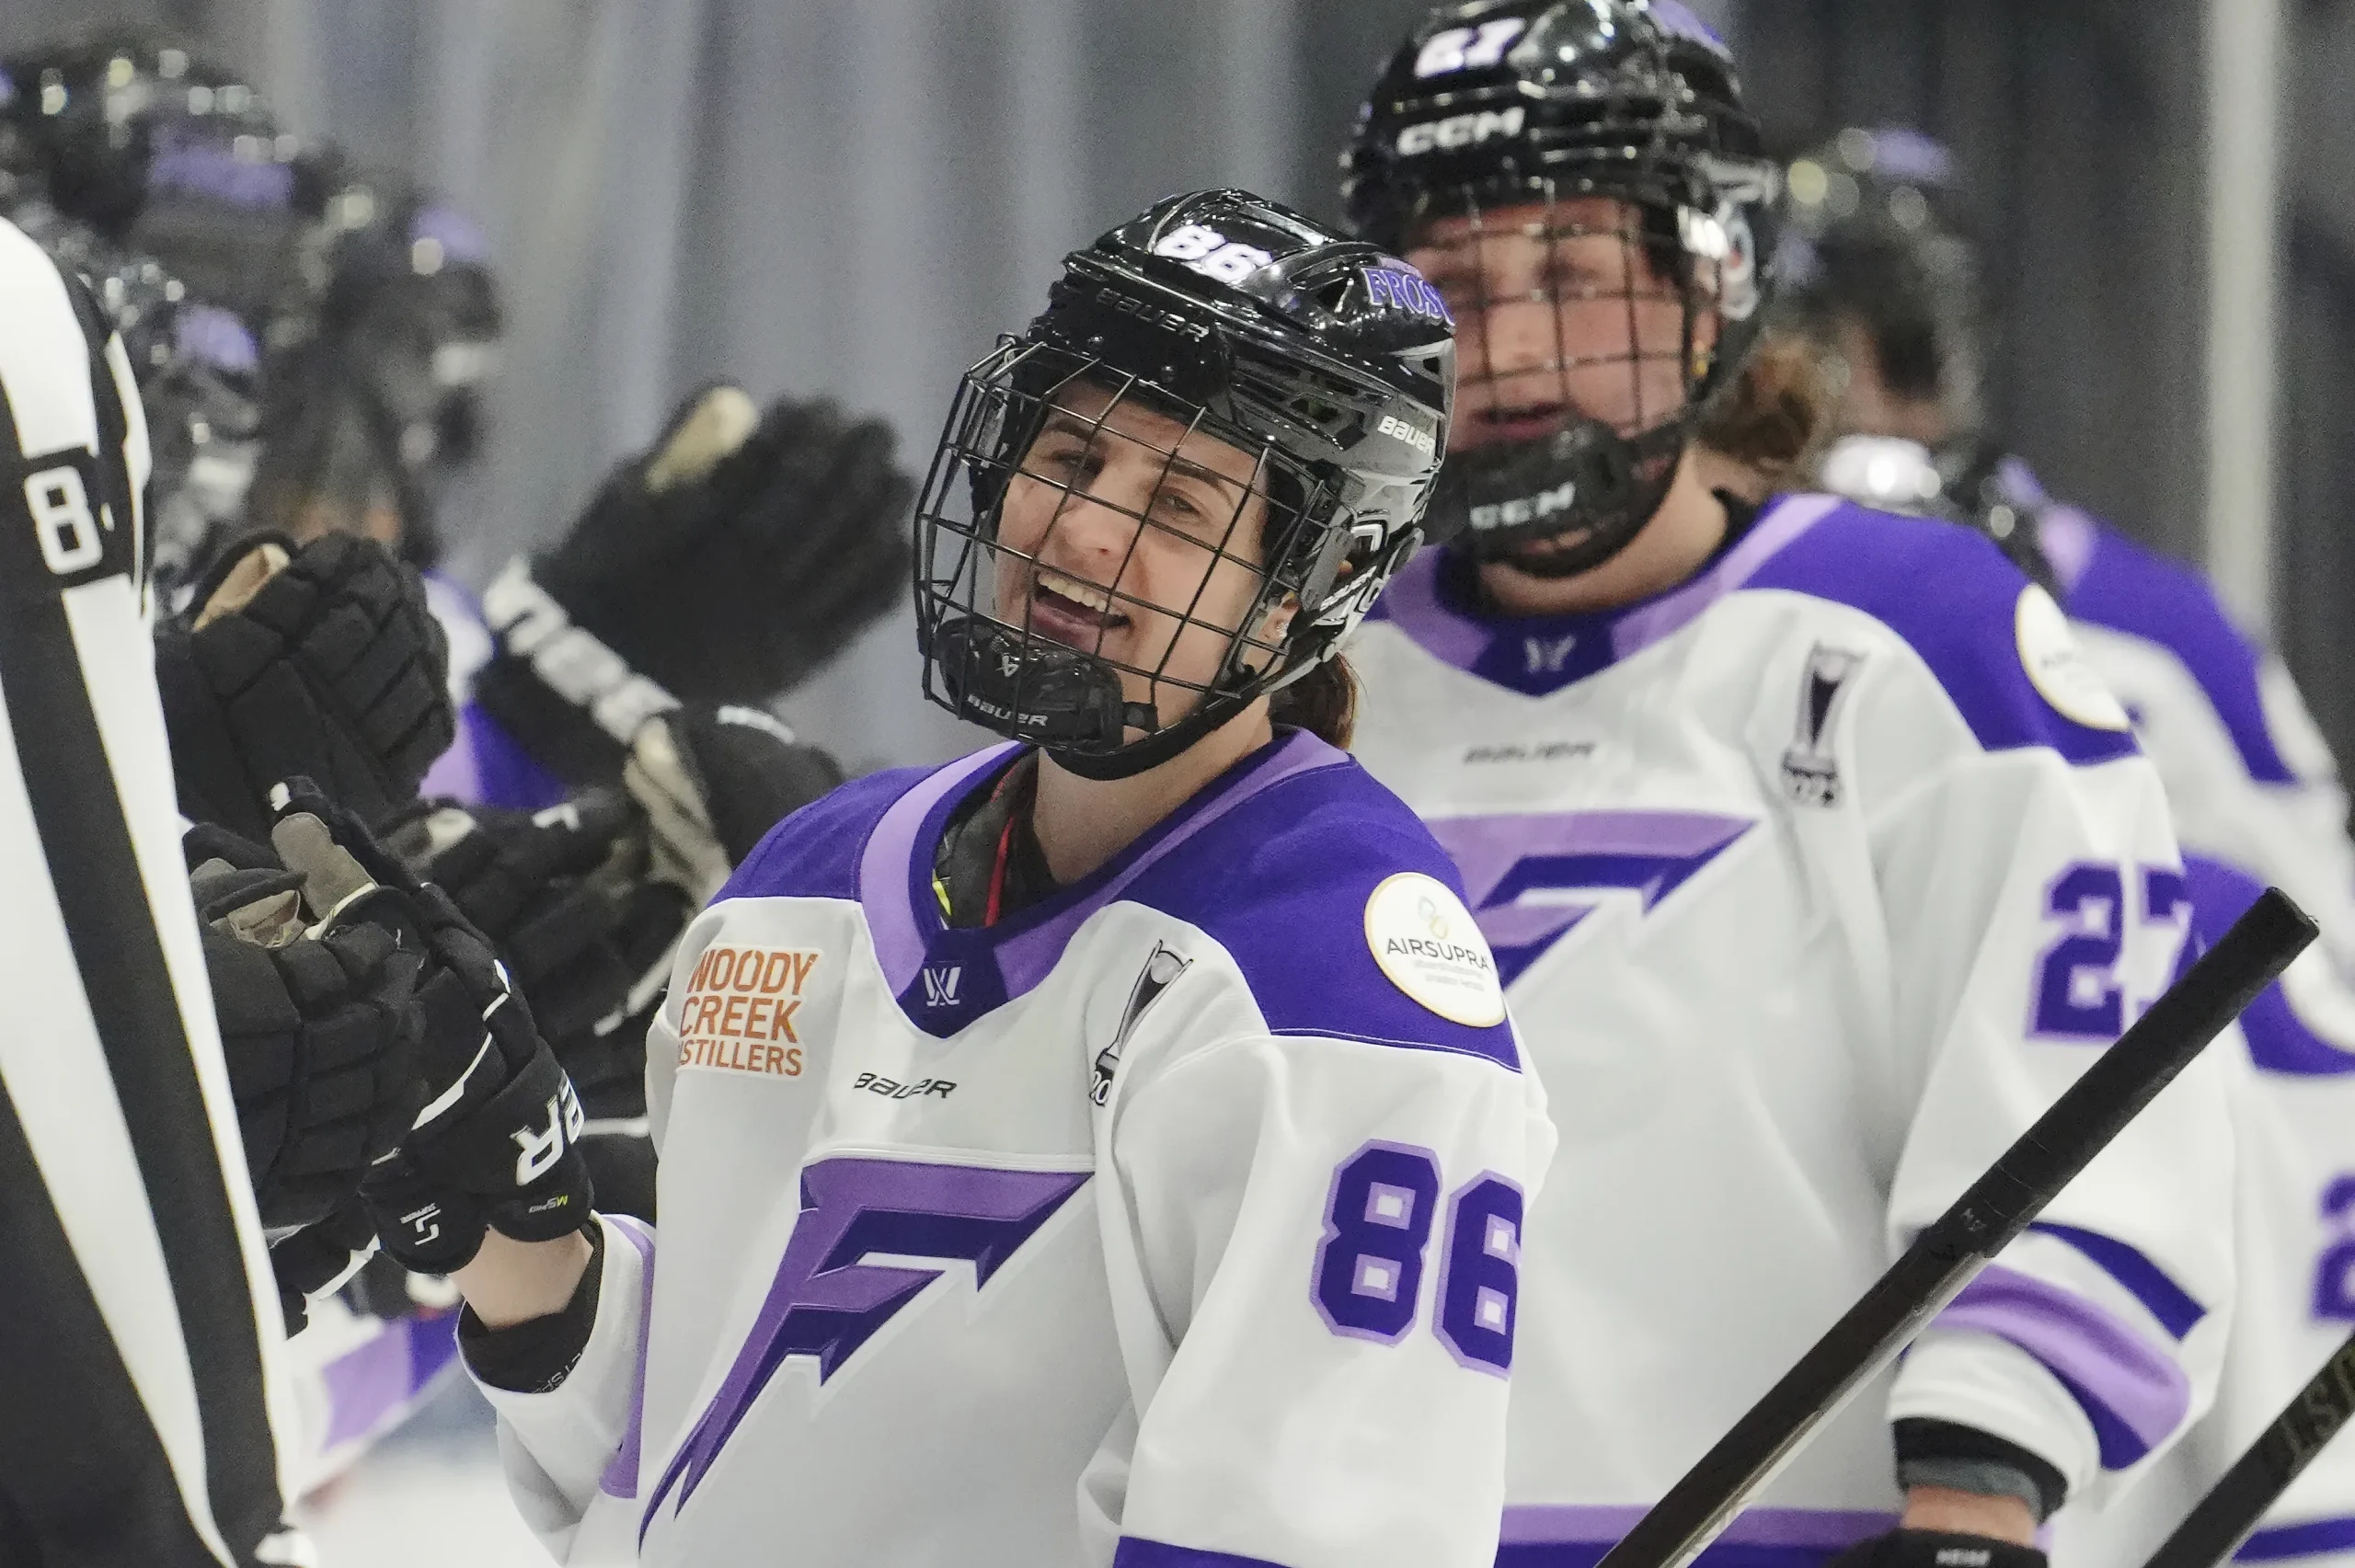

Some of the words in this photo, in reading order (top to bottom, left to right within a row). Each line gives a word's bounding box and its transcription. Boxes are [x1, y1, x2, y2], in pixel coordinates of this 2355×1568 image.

[1396, 106, 1525, 156] CCM
[1153, 224, 1273, 283] 86
[1377, 415, 1436, 457] BAUER
[24, 464, 115, 576] 8
[1386, 938, 1488, 972] AIRSUPRA
[679, 995, 802, 1044] CREEK
[854, 1072, 958, 1099] BAUER
[1308, 1139, 1524, 1381] 86
